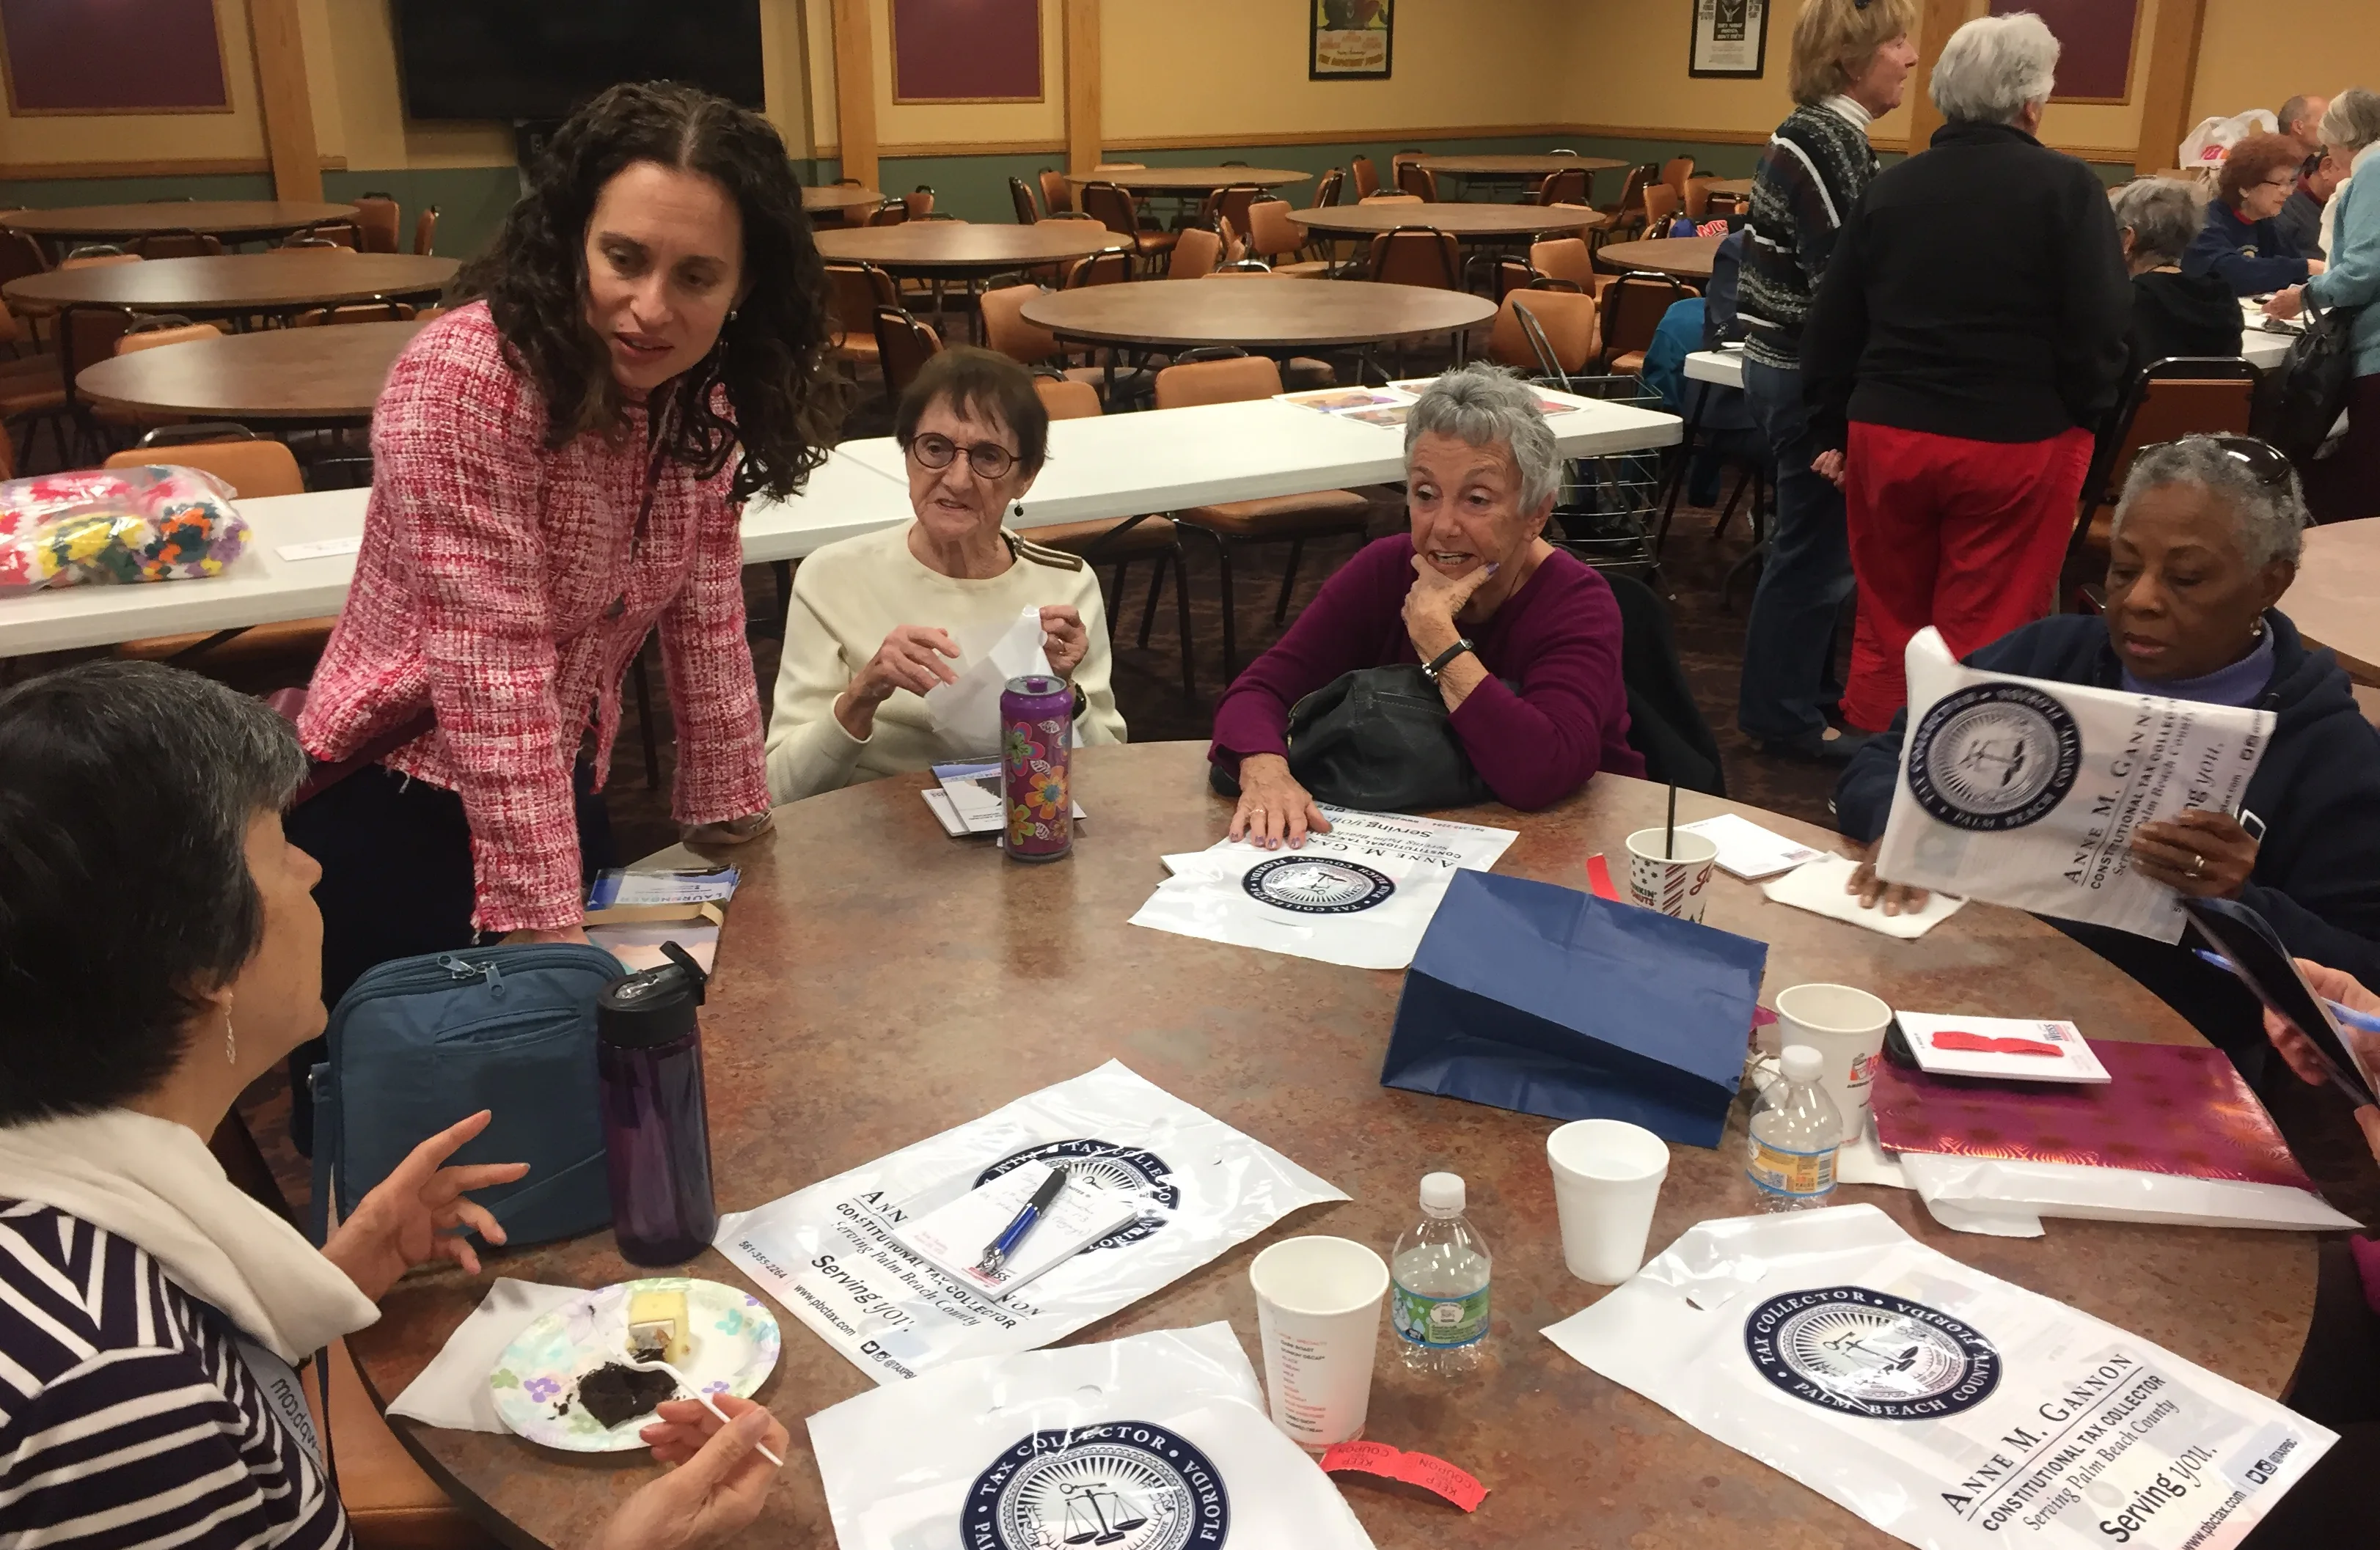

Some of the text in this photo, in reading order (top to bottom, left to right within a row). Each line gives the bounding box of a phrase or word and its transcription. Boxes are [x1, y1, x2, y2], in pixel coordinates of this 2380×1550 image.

[1361, 847, 1385, 856] M.
[1365, 821, 1432, 837] Serving
[1367, 841, 1461, 859] CONSTITUTIONAL
[2064, 826, 2103, 884] ANNE
[2091, 789, 2120, 817] M.
[2091, 793, 2145, 889] CONSTITUTIONAL
[2139, 765, 2156, 787] TAX
[1250, 859, 1289, 881] FLORIDA
[1396, 855, 1454, 867] ANNE
[1070, 1142, 1107, 1154] TAX
[861, 1191, 1047, 1316] ANN NON
[739, 1241, 788, 1279] 561-355-2264
[794, 1284, 856, 1337] www.pbctax.com
[812, 1254, 882, 1304] Serving
[871, 1251, 901, 1274] Palm
[899, 1271, 938, 1300] Beach
[935, 1299, 981, 1326] County
[925, 1267, 949, 1286] TAX
[946, 1285, 1017, 1329] COLLECTOR
[1754, 1290, 1867, 1364] TAX COLLECTOR
[1896, 1302, 1981, 1345] FLORIDA
[1794, 1381, 1854, 1409] PALM
[1870, 1399, 1949, 1416] BEACH
[1337, 1445, 1390, 1458] COUPON
[1941, 1354, 2133, 1515] ANNE M. GANNON
[1982, 1375, 2166, 1531] CONSTITUTIONAL TAX COLLECTOR
[981, 1426, 1170, 1496] TAX COLLECTOR
[1341, 1458, 1373, 1466] KEEP
[1419, 1458, 1472, 1489] COUPON
[2023, 1399, 2180, 1530] Serving Palm Beach County
[974, 1459, 1221, 1550] PAL FLORIDA
[1426, 1477, 1457, 1496] KEEP
[2099, 1445, 2218, 1543] Serving you.
[1141, 1521, 1169, 1550] ISTRIBUTE
[2181, 1490, 2247, 1550] www.pbctax.com
